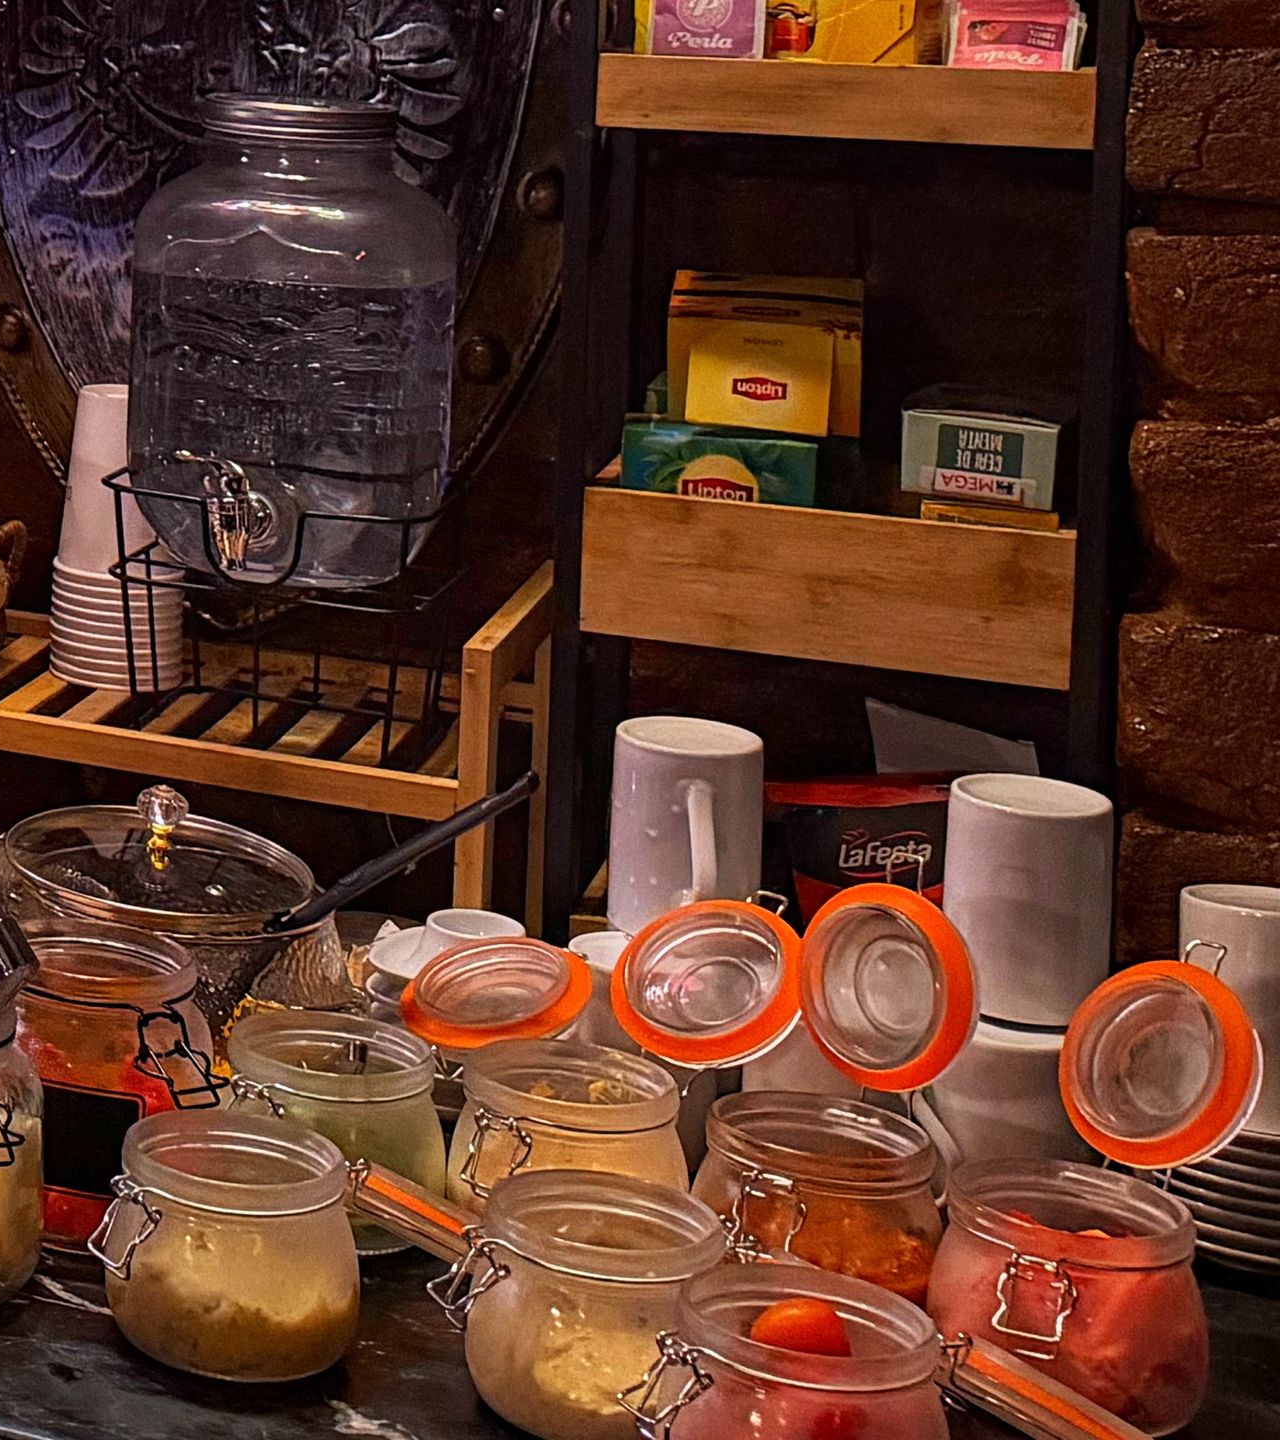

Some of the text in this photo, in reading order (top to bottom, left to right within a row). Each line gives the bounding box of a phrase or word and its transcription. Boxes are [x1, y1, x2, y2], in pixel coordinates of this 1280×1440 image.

[667, 31, 734, 50] Perla
[973, 50, 1044, 66] Perla
[736, 381, 784, 398] Lipton
[954, 449, 1004, 473] CEAI DE
[940, 473, 995, 494] MEGA
[838, 840, 934, 868] LaFesta
